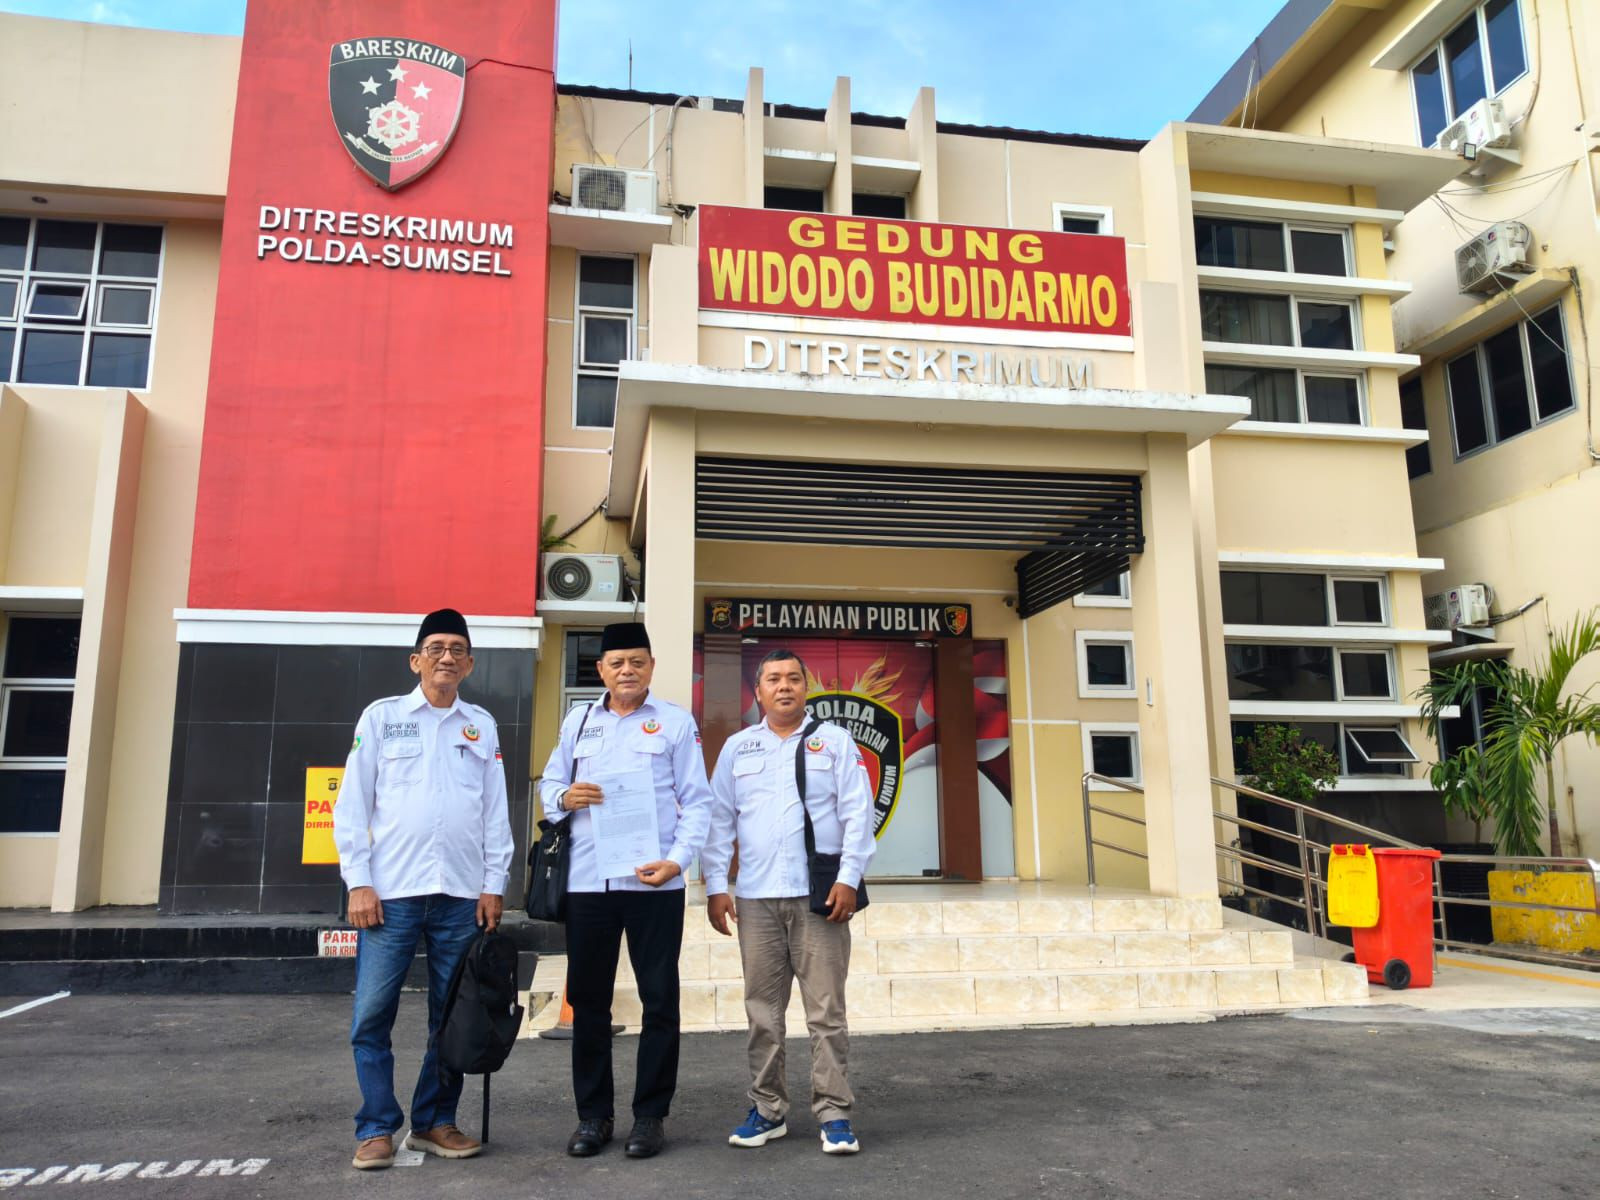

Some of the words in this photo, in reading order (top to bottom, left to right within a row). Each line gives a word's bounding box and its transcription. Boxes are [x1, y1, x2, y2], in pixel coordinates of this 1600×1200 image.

[340, 39, 458, 70] BARESKRIM
[258, 205, 514, 247] DITRESKRIMUM
[788, 216, 1045, 264] GEDUNG
[257, 234, 512, 276] POLDA-SUMSEL
[709, 247, 875, 312] WIDODO
[888, 260, 1118, 329] BUDIDARMO
[743, 334, 1094, 390] DITRESKRIMUM
[739, 603, 860, 630] PELAYANAN
[867, 606, 941, 632] PUBLIK
[879, 764, 897, 806] UMUM
